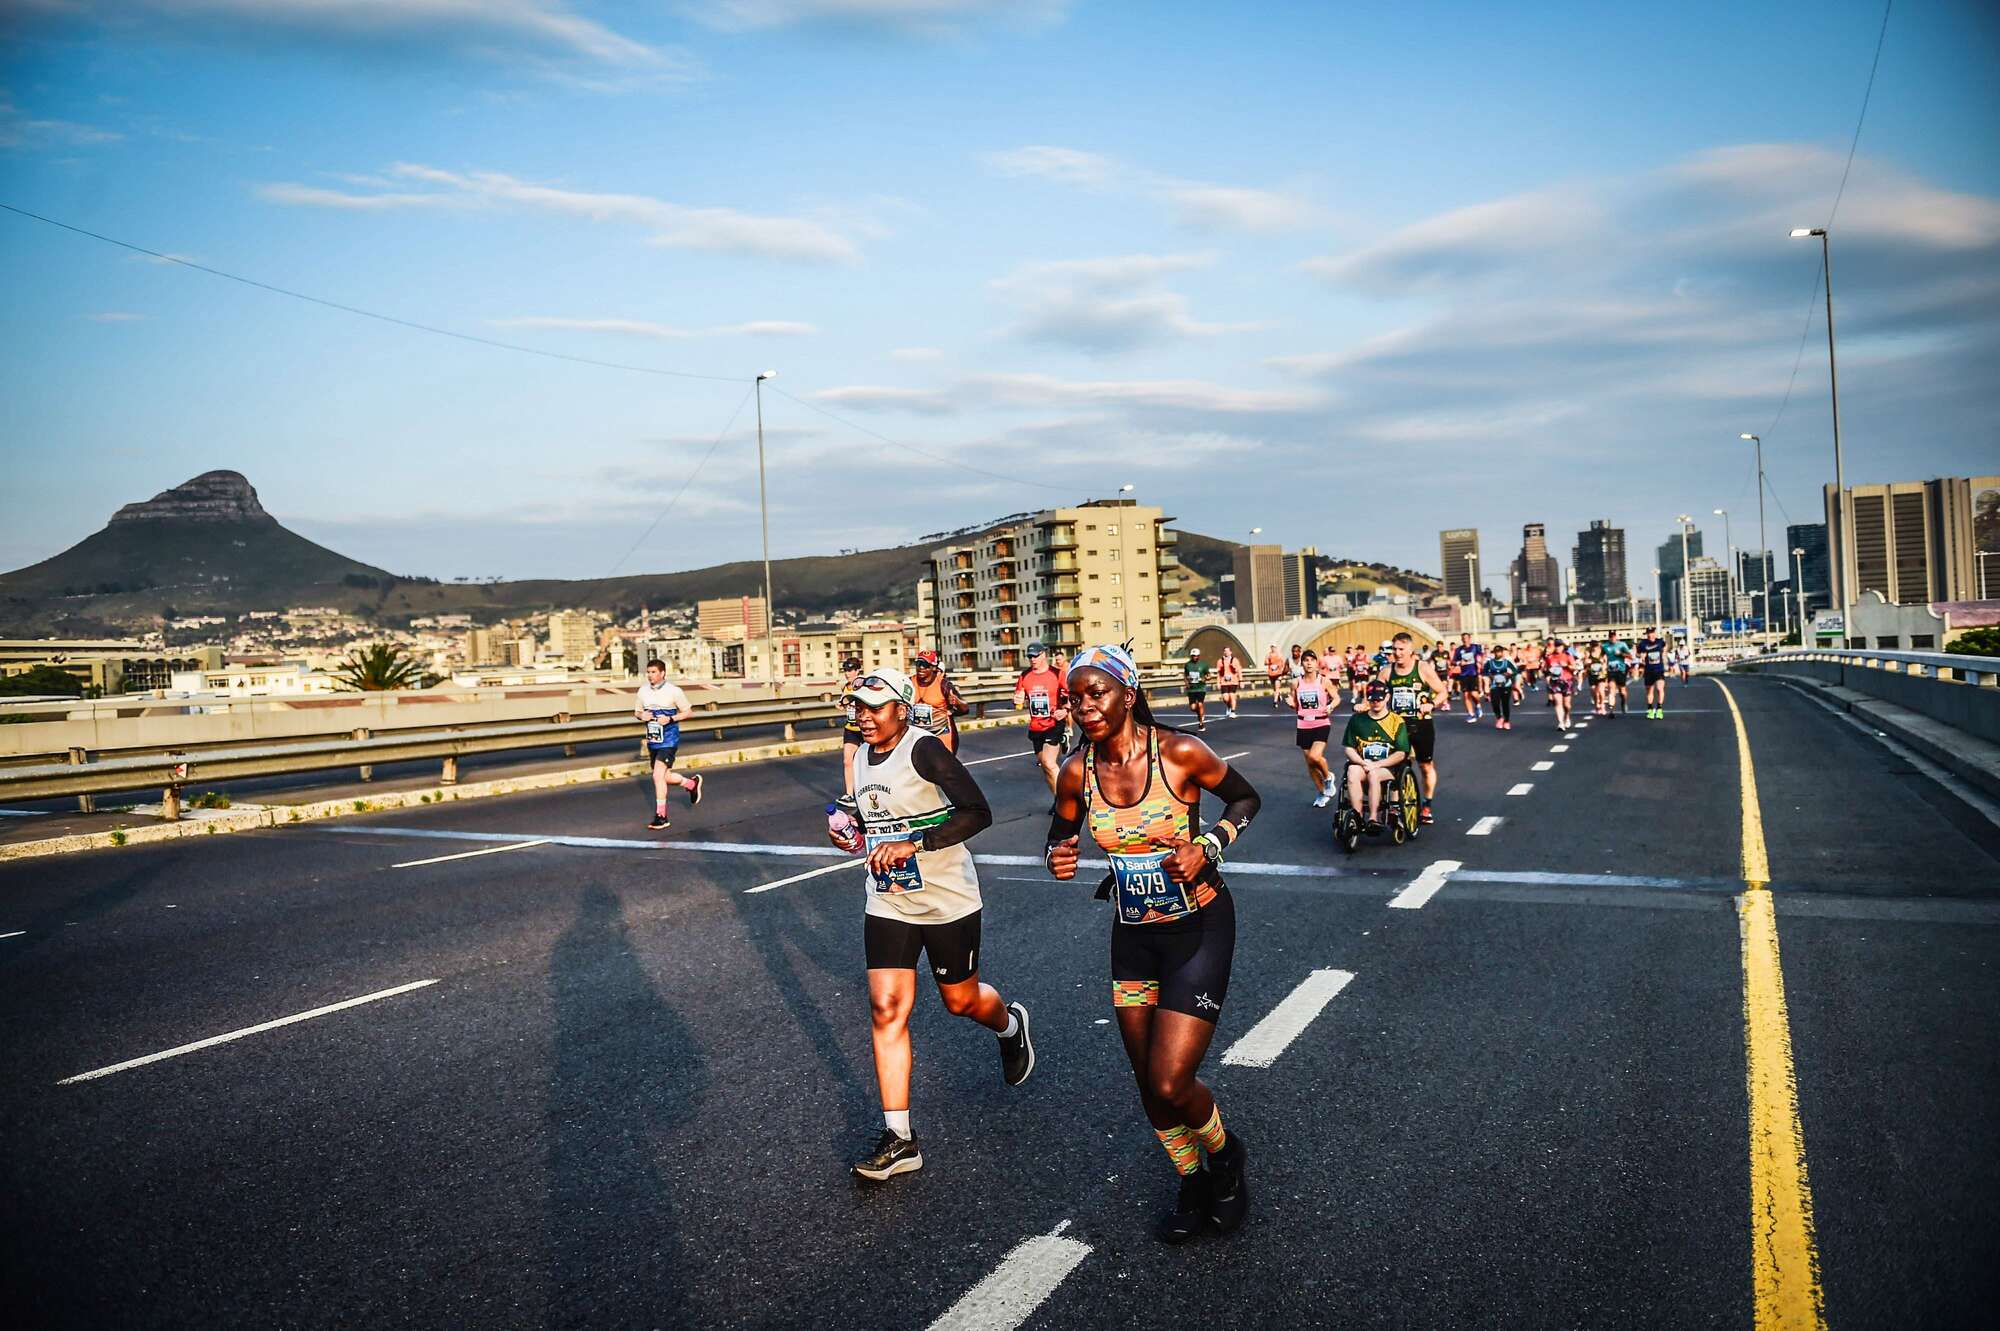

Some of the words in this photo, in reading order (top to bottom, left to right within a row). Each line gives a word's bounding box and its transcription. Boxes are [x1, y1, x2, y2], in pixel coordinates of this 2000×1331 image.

[857, 783, 891, 798] CORRECTIONAL
[867, 809, 890, 818] SERVICES
[1126, 872, 1166, 895] 4379
